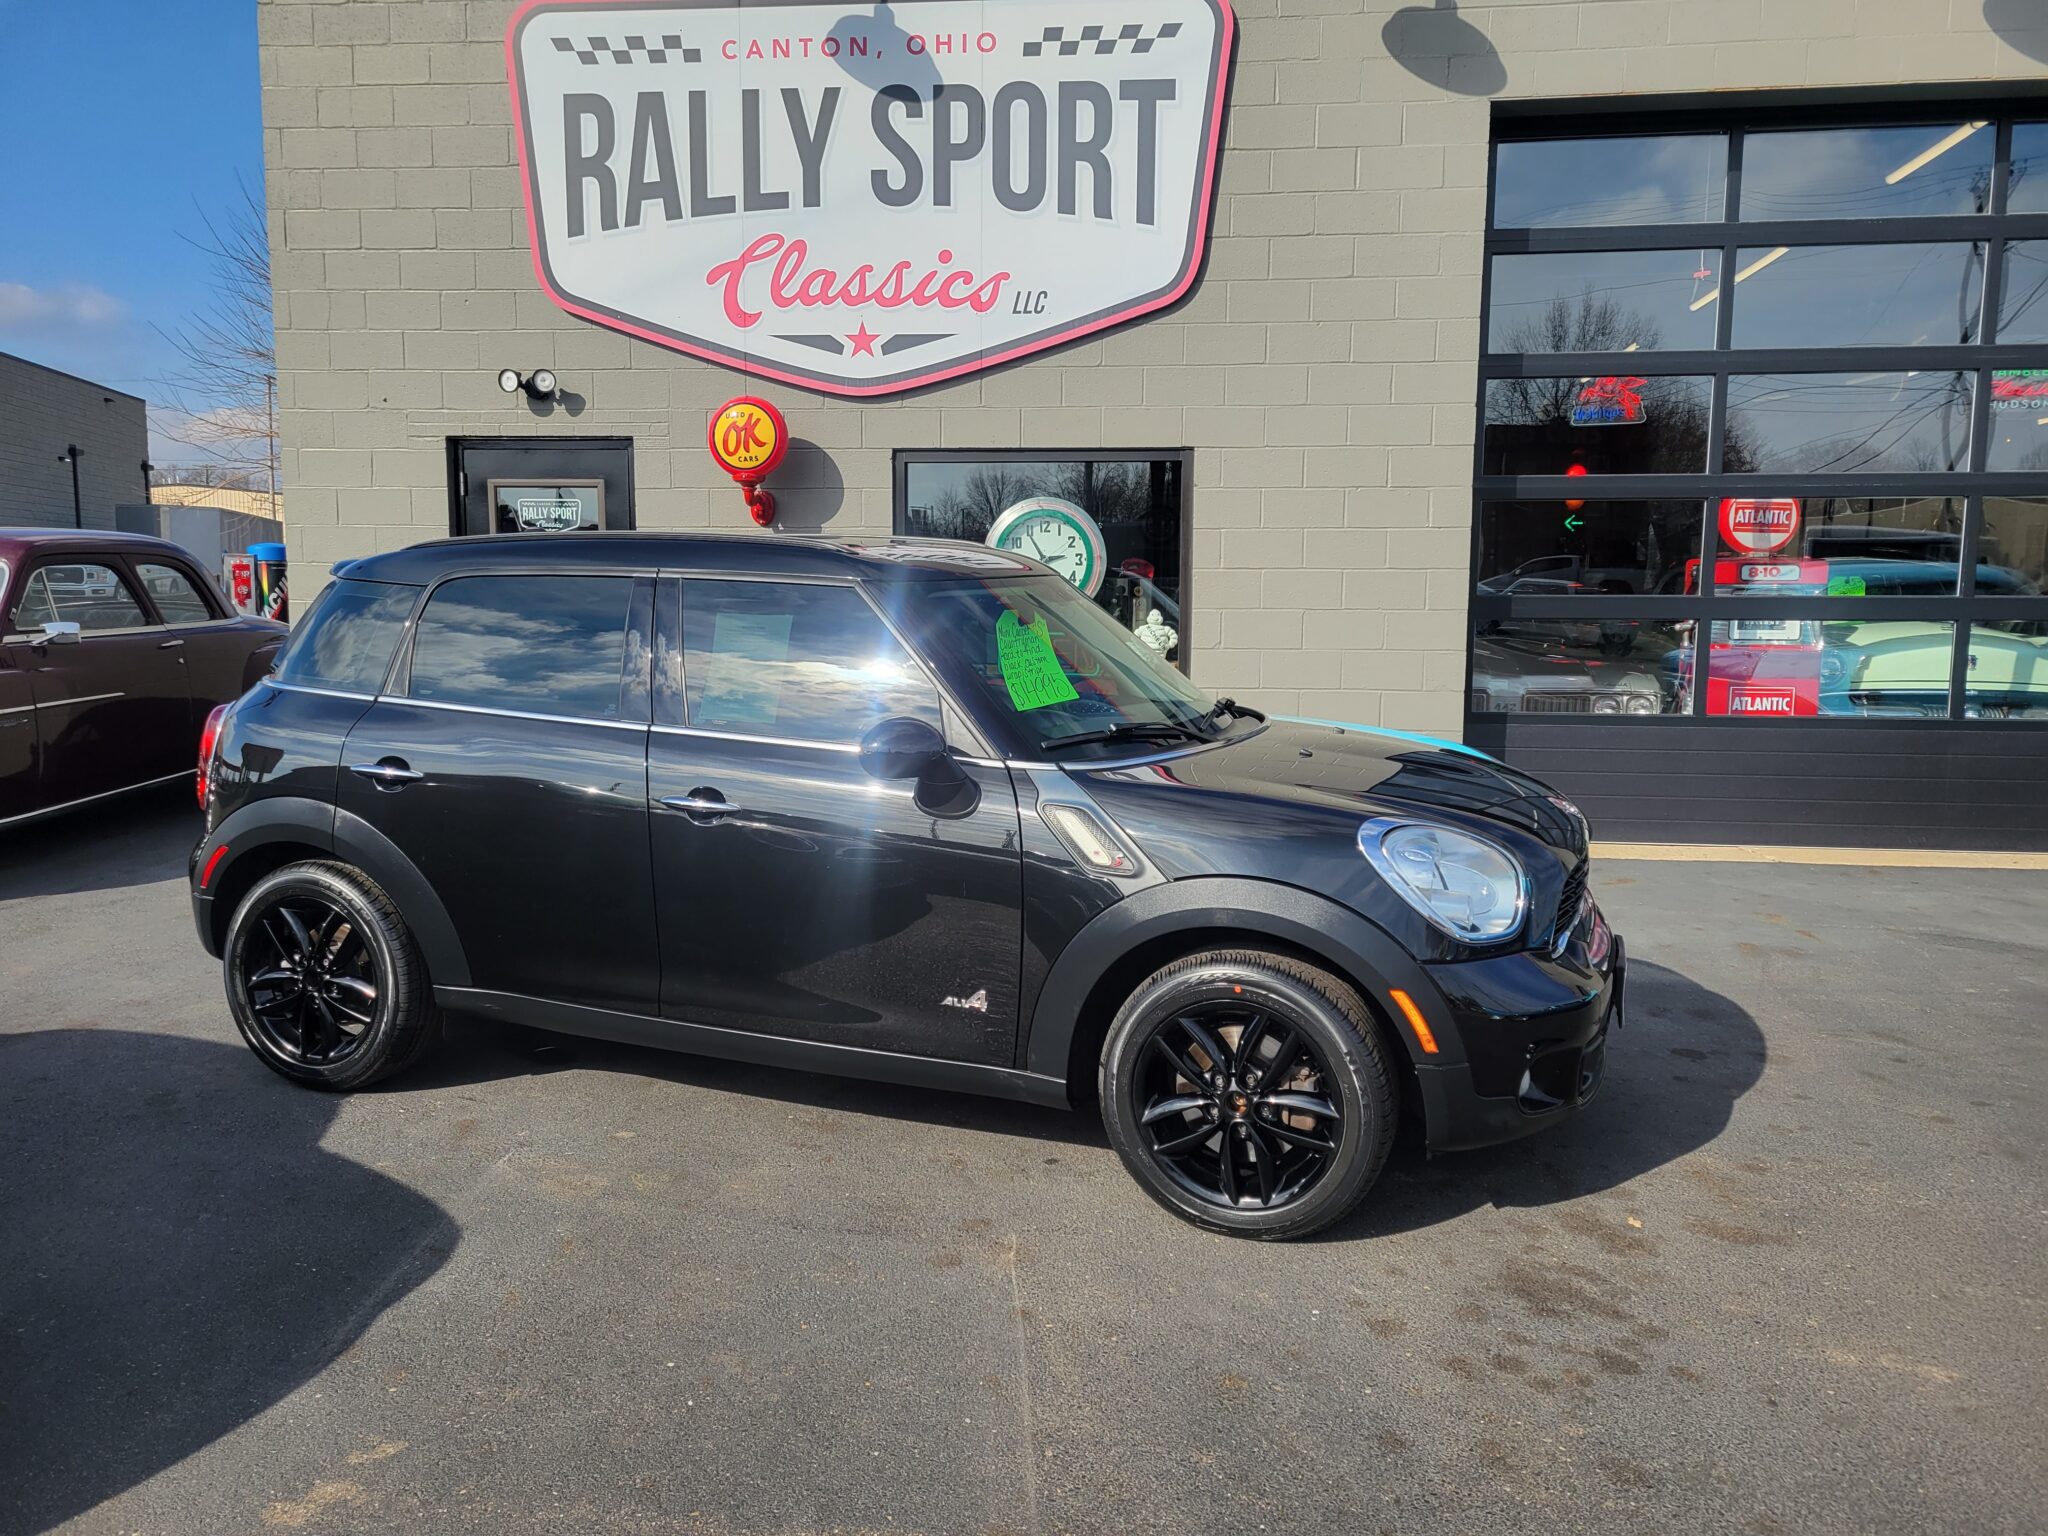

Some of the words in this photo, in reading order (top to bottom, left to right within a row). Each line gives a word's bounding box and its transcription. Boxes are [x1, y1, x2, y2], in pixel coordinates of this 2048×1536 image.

[721, 36, 882, 60] CANTON,
[906, 32, 997, 55] OHIO
[562, 87, 841, 239] RALLY
[870, 79, 1177, 226] SPORT
[706, 232, 1010, 328] Classics
[1012, 290, 1049, 315] LLC
[723, 412, 768, 457] OK
[522, 507, 548, 521] RALLY
[550, 507, 577, 521] SPORT
[1735, 509, 1791, 525] ATLANTIC
[1040, 520, 1051, 533] 12
[1058, 524, 1062, 536] 1
[1011, 537, 1022, 549] 10
[1067, 536, 1076, 548] 2
[1075, 553, 1083, 566] 3
[1068, 570, 1077, 583] 4
[1732, 696, 1791, 711] ATLANTIC
[940, 989, 988, 1012] ALL4
